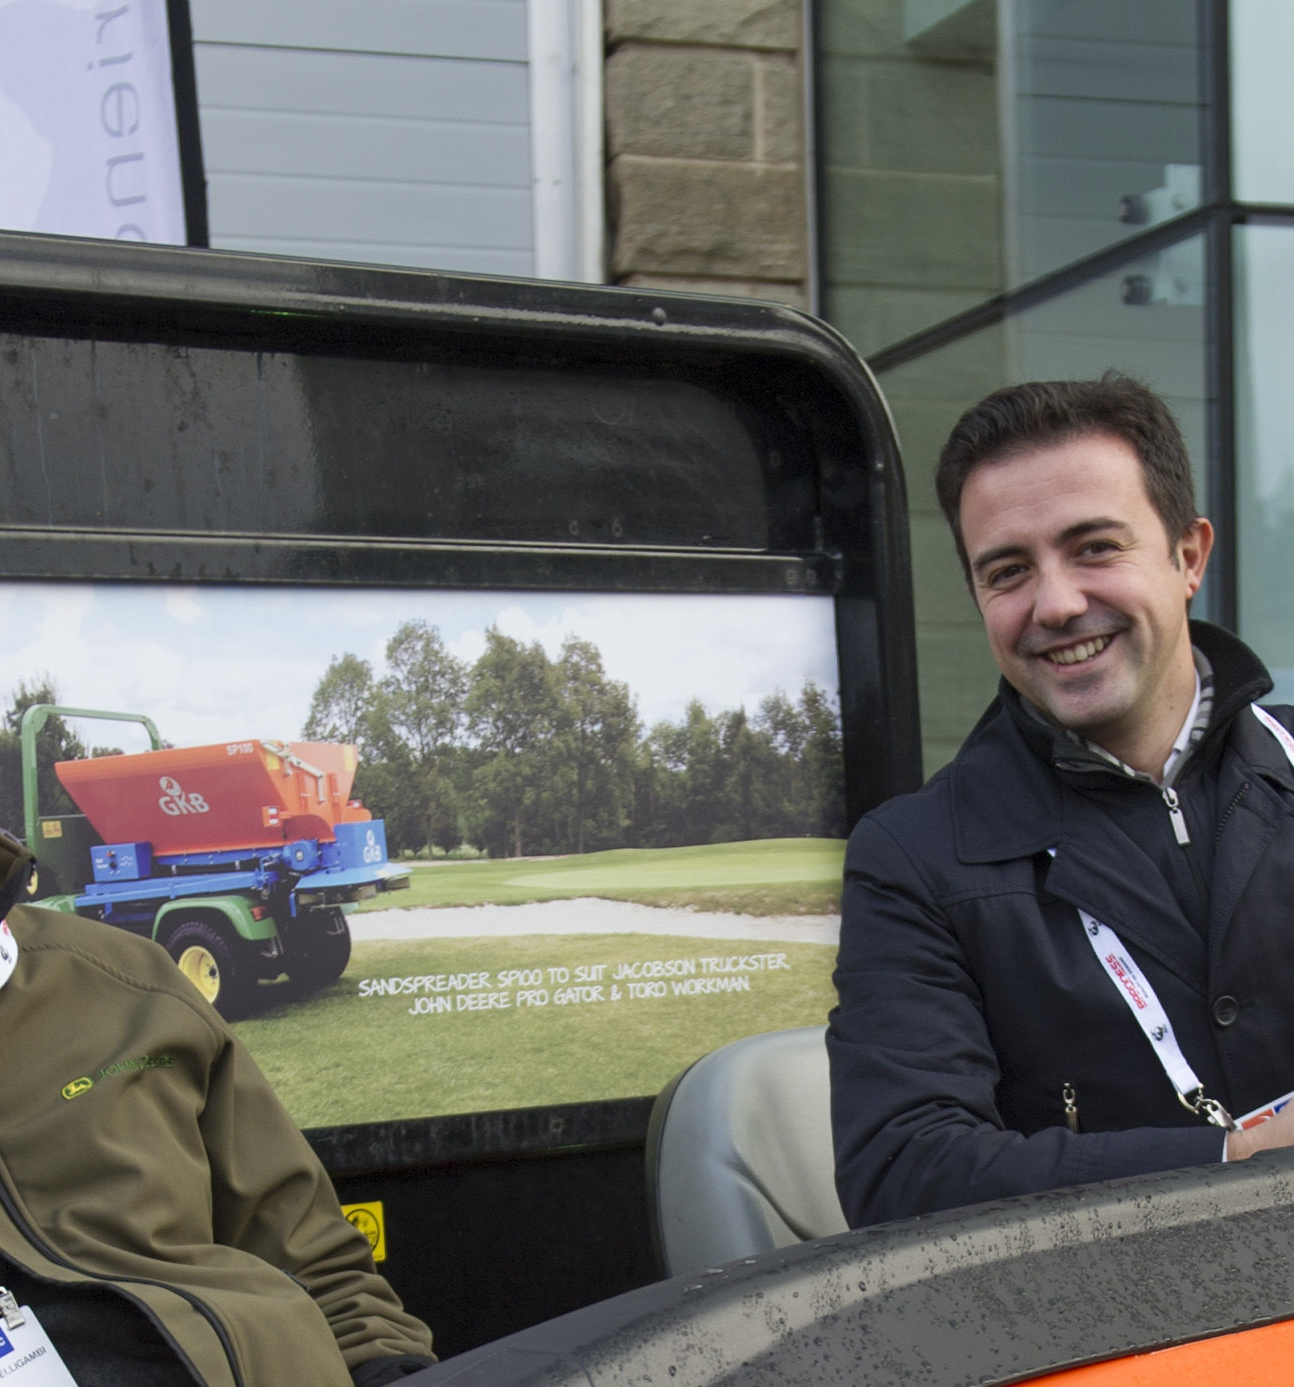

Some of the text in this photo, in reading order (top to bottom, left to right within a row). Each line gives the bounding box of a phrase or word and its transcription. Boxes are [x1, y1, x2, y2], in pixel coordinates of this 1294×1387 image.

[159, 791, 210, 816] GKB
[358, 971, 492, 997] SANDSPREADER
[547, 966, 570, 984] TO
[574, 964, 607, 982] SUIT
[612, 958, 696, 980] JACOBSON
[700, 953, 791, 974] TRUCKSTER
[408, 995, 452, 1015] JOHN
[456, 991, 512, 1011] DEERE
[515, 989, 548, 1007] PRO
[554, 985, 605, 1005] GATOR
[610, 984, 622, 1001] &
[627, 981, 667, 1000] TORO
